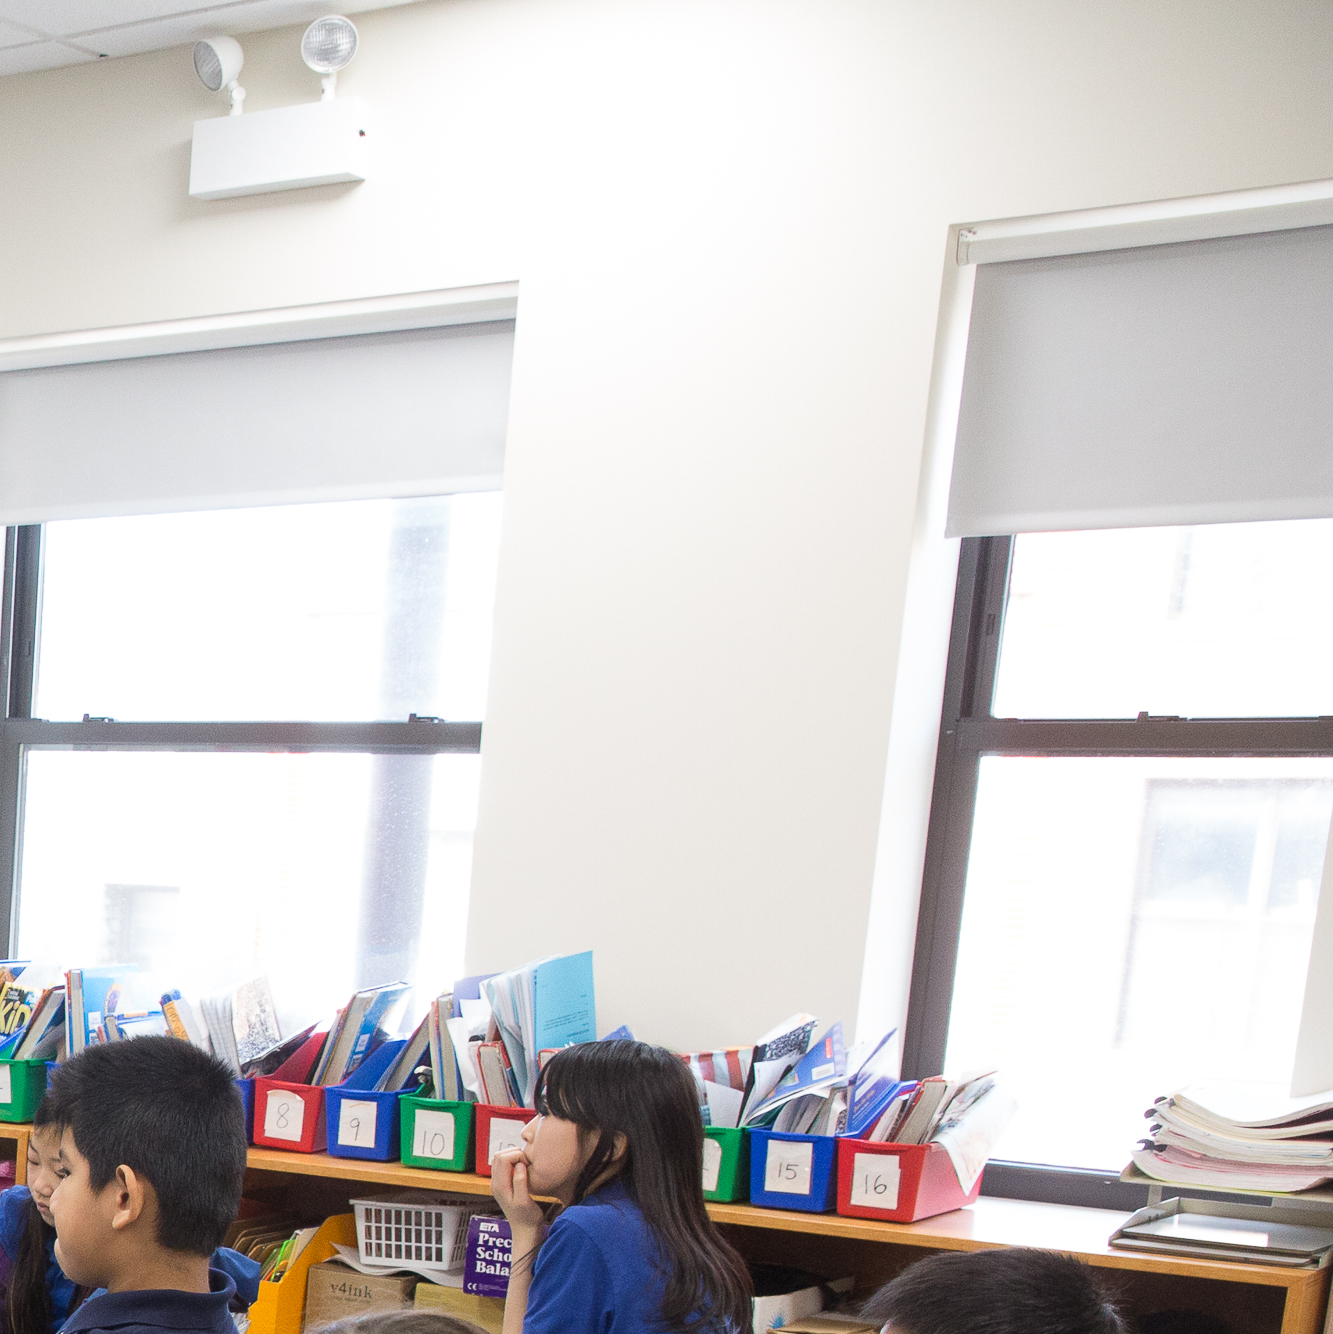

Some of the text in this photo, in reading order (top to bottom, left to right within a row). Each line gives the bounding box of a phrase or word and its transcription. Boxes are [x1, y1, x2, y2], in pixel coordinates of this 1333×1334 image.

[276, 1103, 289, 1128] 8
[350, 1117, 361, 1141] 9
[422, 1131, 445, 1156] 10
[778, 1162, 800, 1180] 15
[864, 1174, 888, 1195] 16
[479, 1222, 499, 1232] ETA
[477, 1233, 512, 1248] Prec
[476, 1247, 512, 1262] Scho
[475, 1261, 510, 1277] Bala
[330, 1281, 373, 1299] v4ink
